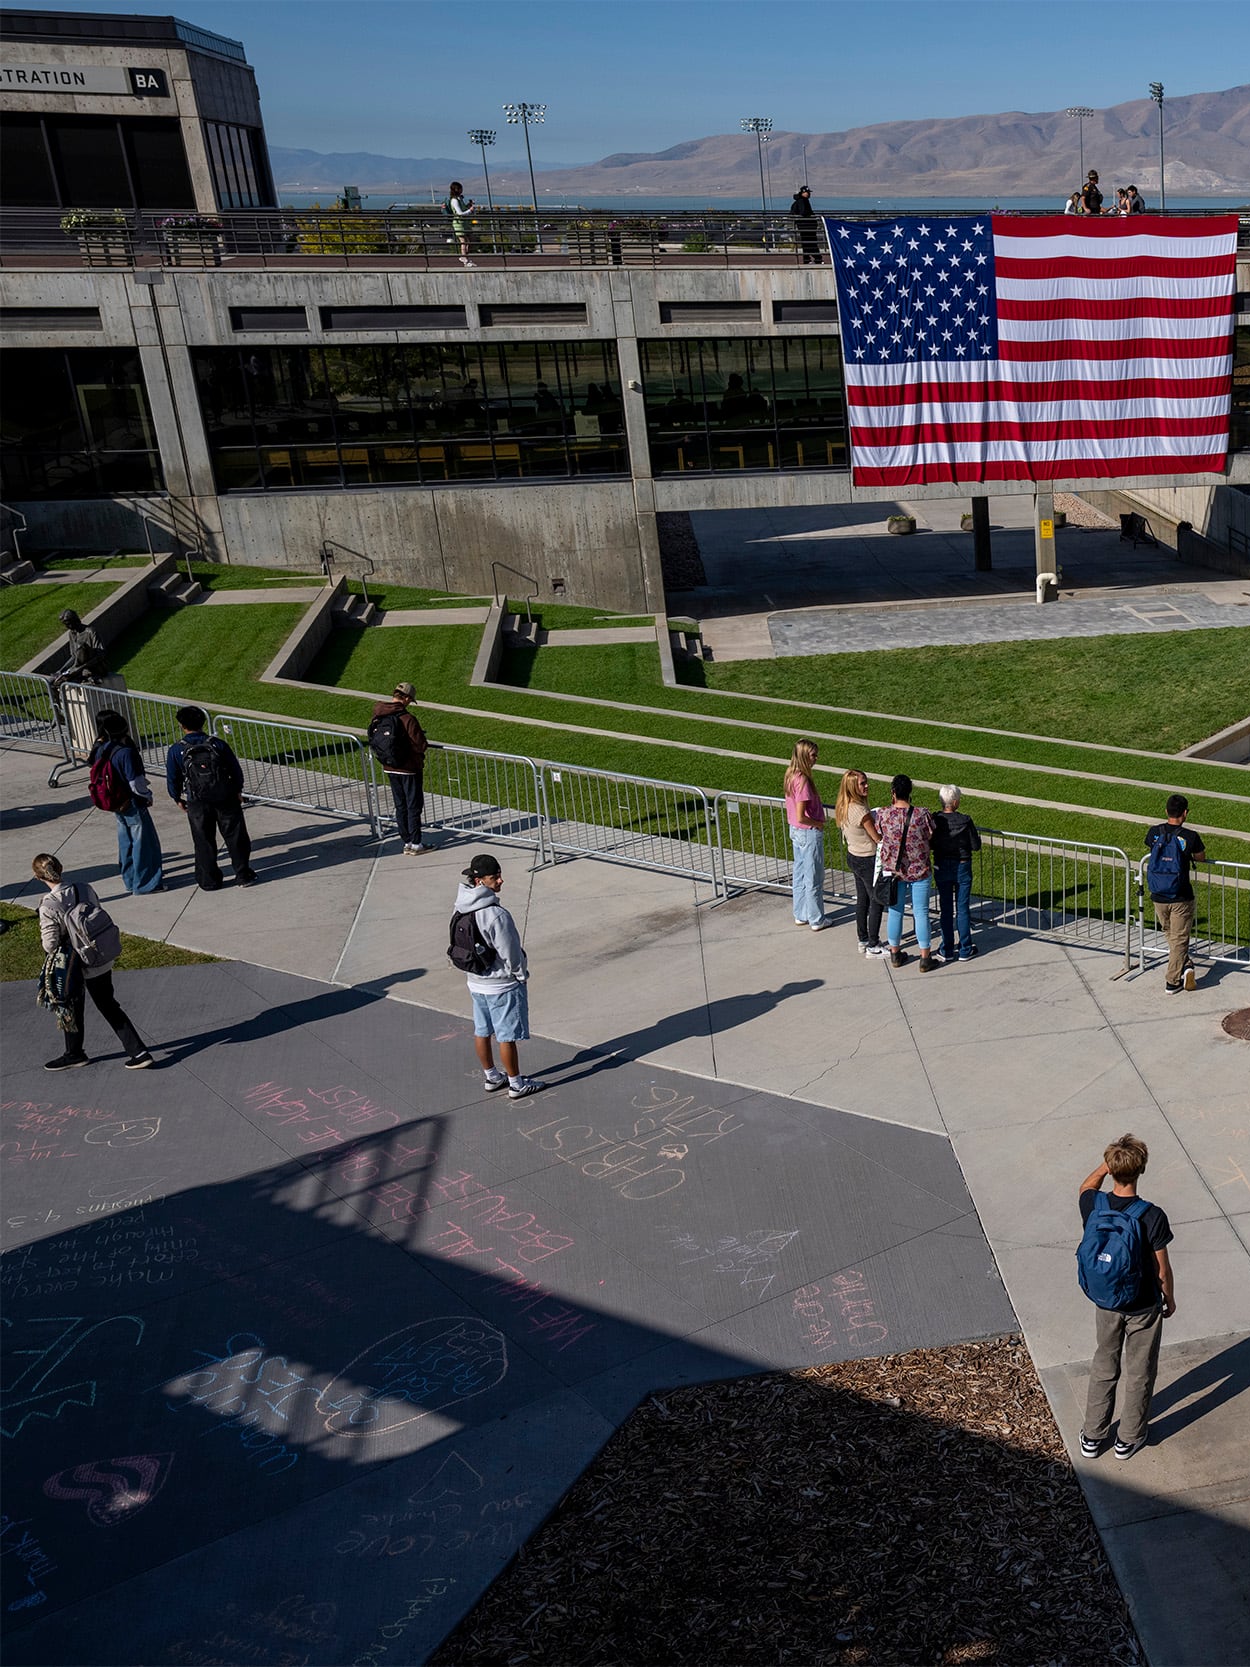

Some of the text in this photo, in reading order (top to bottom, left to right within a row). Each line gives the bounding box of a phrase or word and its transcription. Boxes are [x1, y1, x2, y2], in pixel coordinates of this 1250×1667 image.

[0, 70, 85, 86] TRATION
[136, 74, 160, 89] BA
[630, 1086, 745, 1146] KING
[515, 1115, 687, 1202] CHRIST
[368, 1182, 432, 1225] SEE
[431, 1169, 576, 1264] BECAUSE
